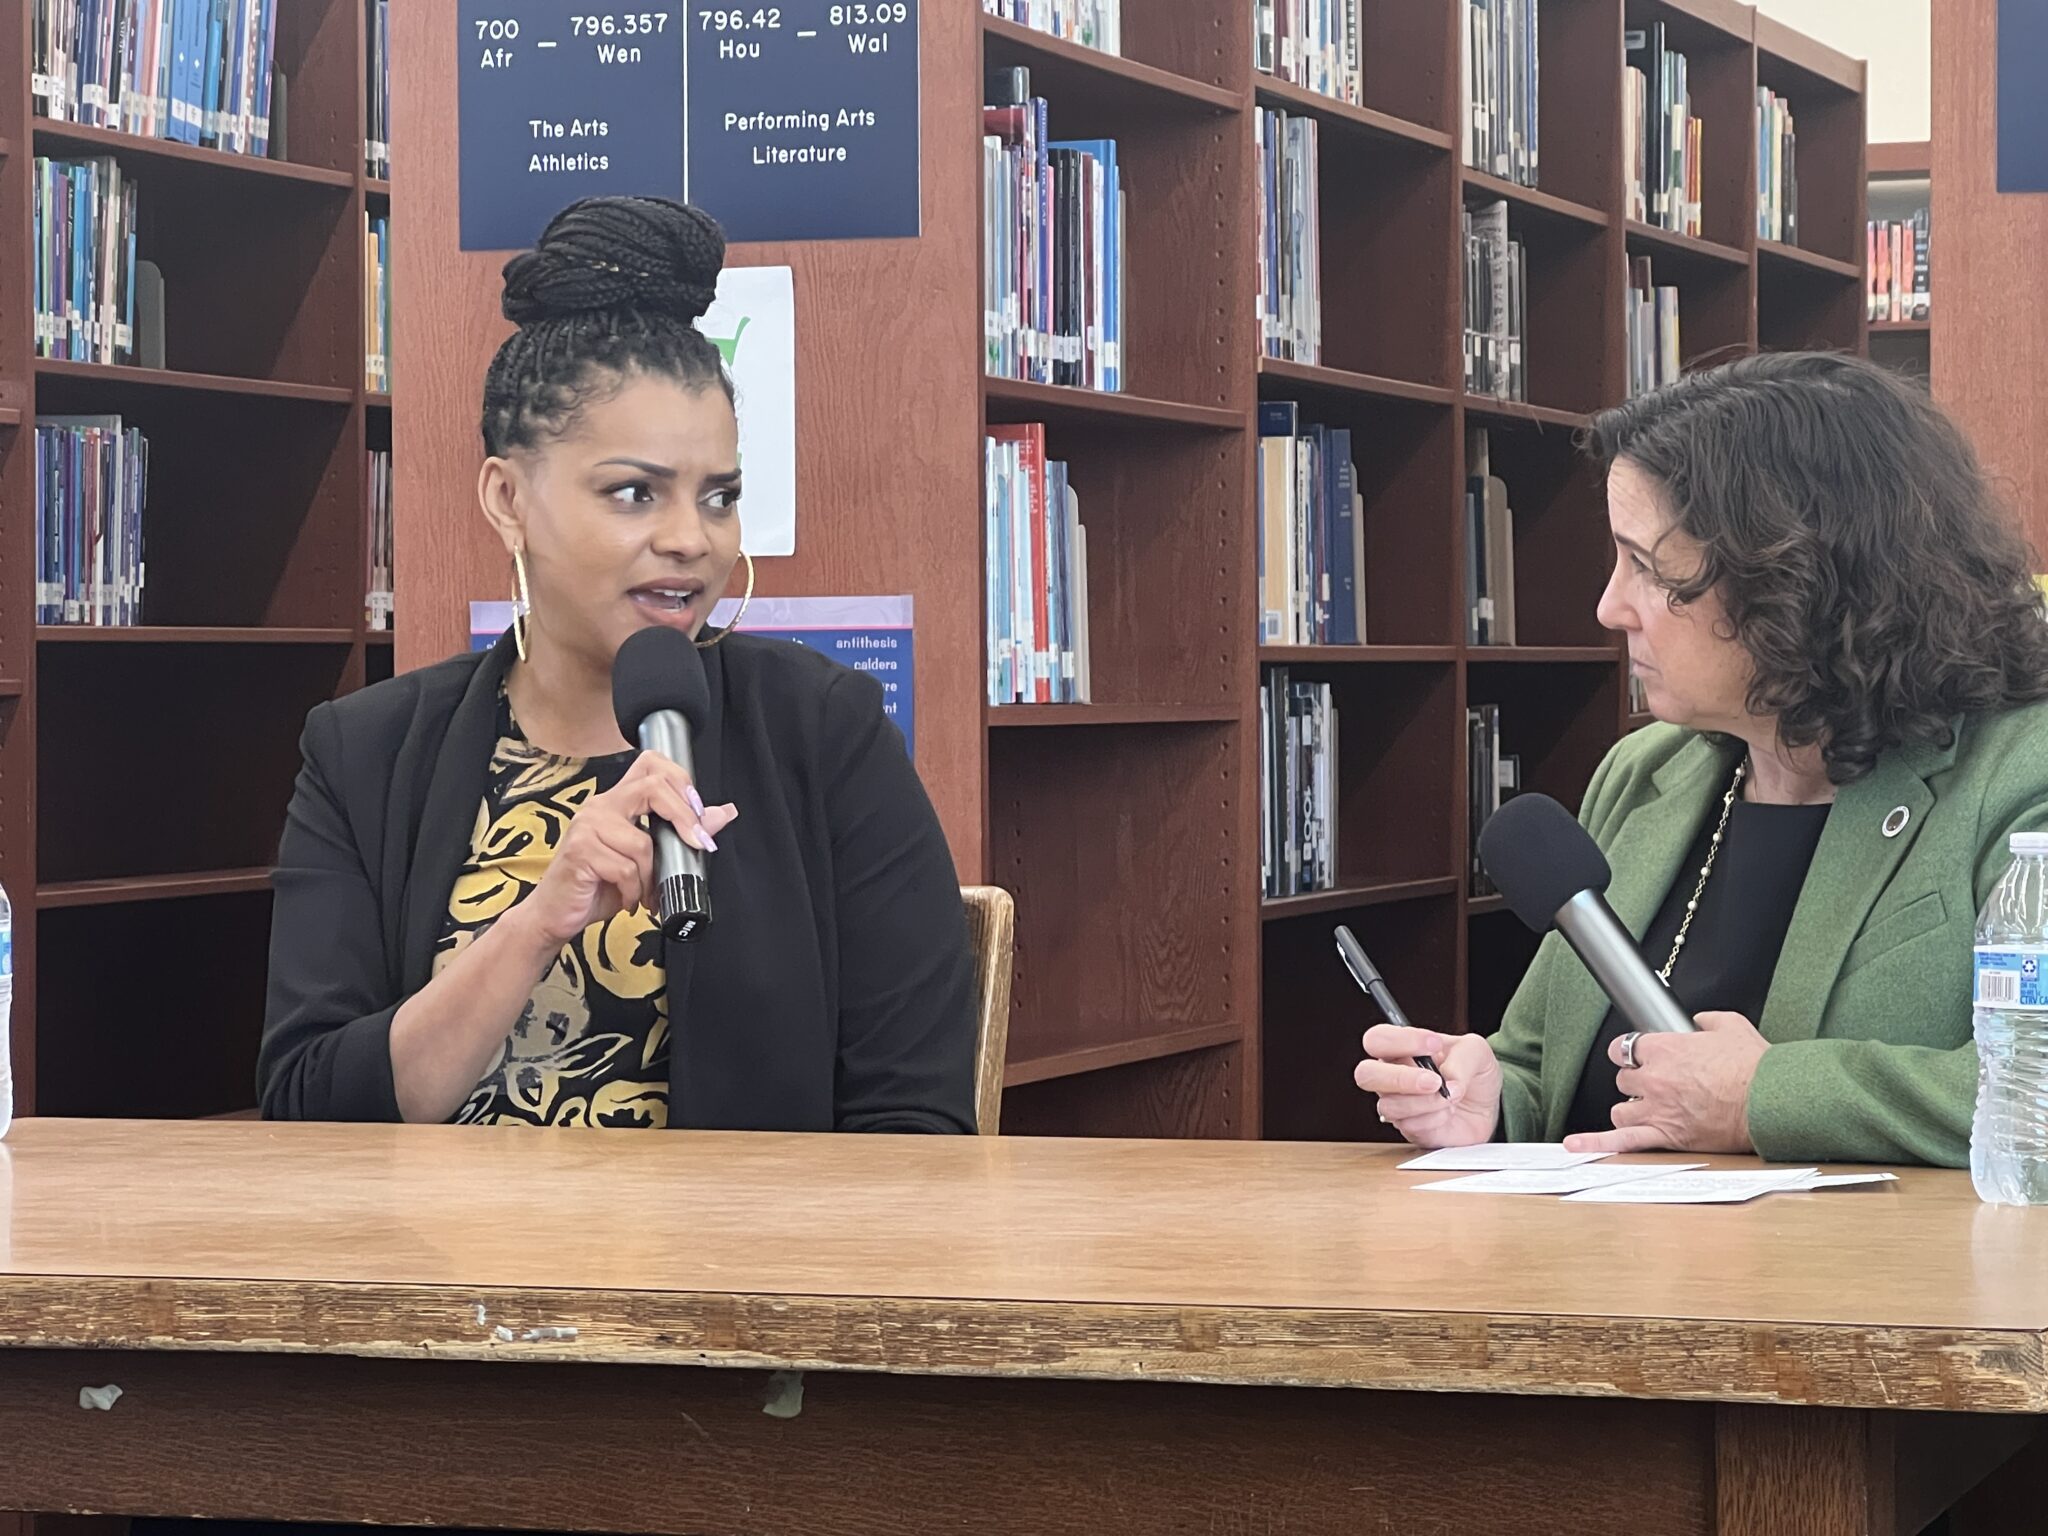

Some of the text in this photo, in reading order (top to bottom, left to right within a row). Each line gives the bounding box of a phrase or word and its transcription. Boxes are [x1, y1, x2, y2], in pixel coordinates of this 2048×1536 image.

[475, 20, 519, 40] 700
[570, 13, 668, 36] 796.357
[698, 9, 781, 31] 796.42
[829, 3, 907, 26] 813.09
[480, 44, 641, 68] Afr Wen
[719, 32, 888, 59] Hou Wal
[528, 118, 609, 139] The Arts
[724, 108, 875, 132] Performing Arts
[528, 153, 609, 172] Athletics
[753, 145, 847, 165] Literature
[836, 635, 898, 649] antithesis
[853, 657, 898, 670] caldera
[678, 920, 697, 937] MIC
